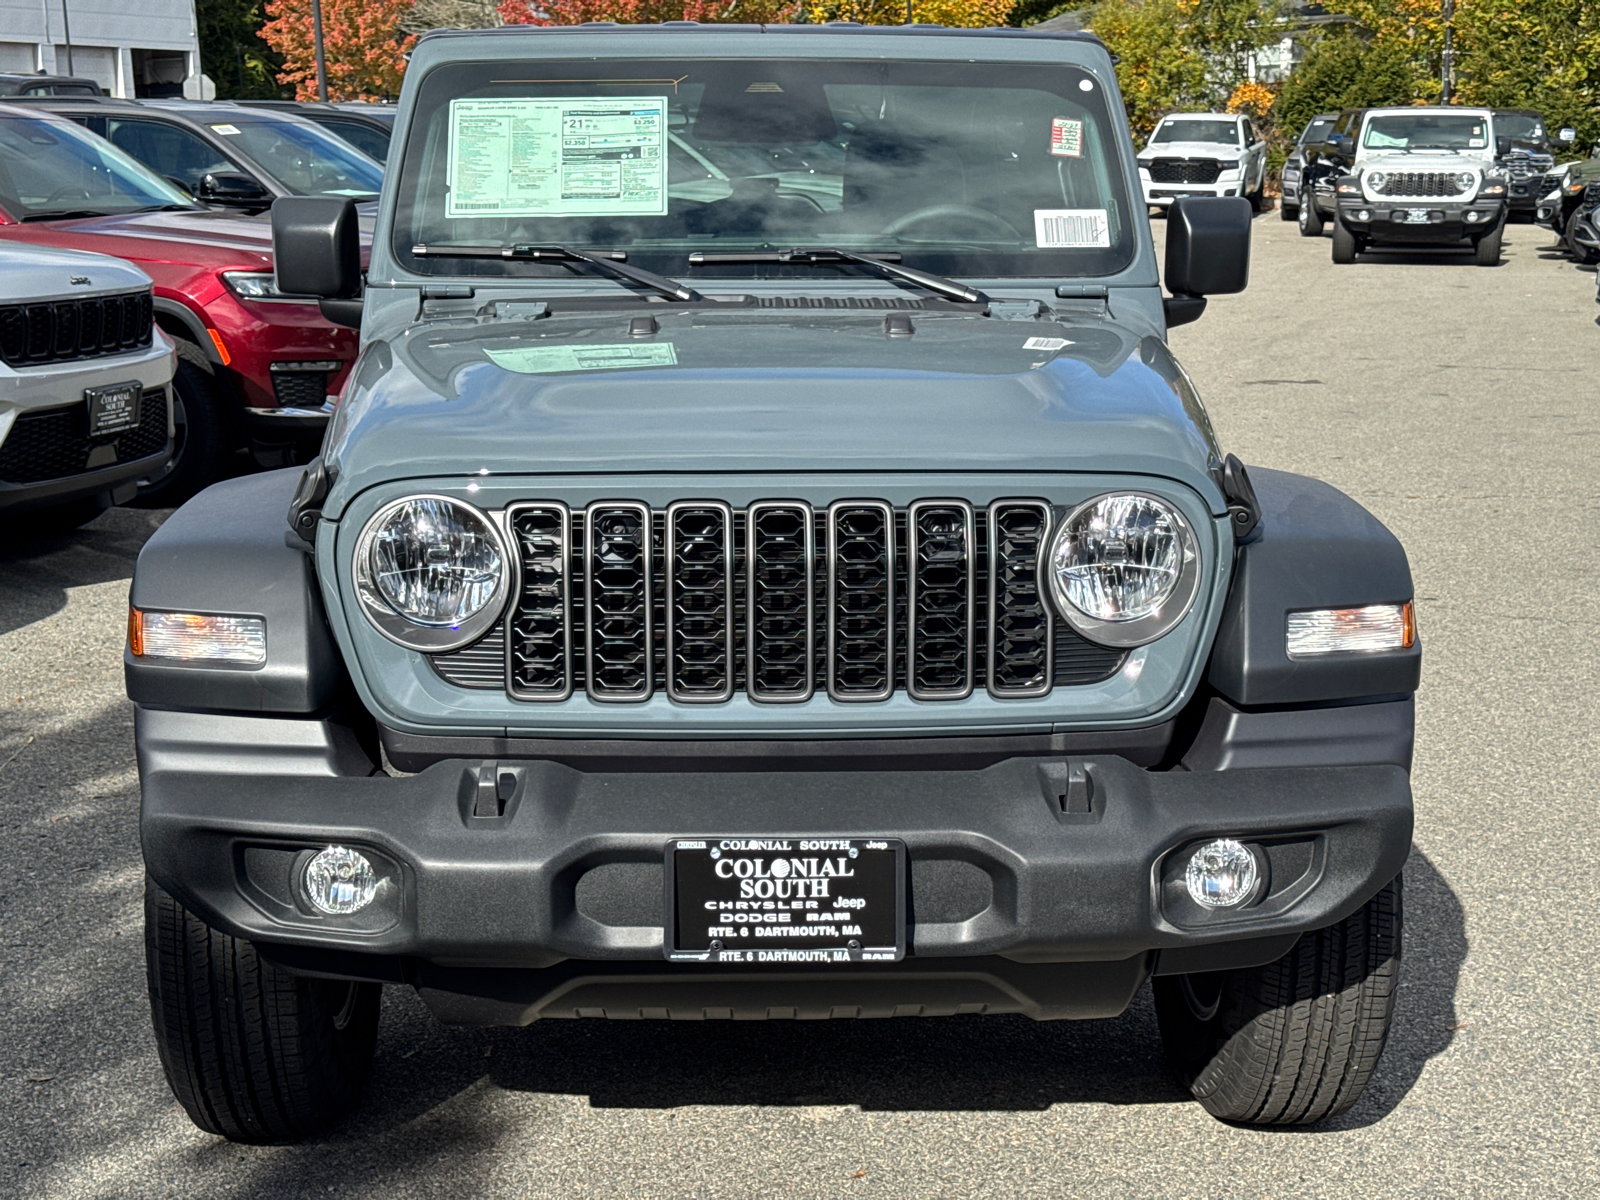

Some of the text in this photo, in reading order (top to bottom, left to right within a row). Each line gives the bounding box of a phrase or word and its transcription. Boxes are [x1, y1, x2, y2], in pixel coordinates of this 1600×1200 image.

[569, 119, 583, 128] 21
[720, 840, 851, 851] COLONIAL SOUTH
[865, 841, 888, 850] Jeep
[715, 857, 855, 879] COLONIAL
[740, 878, 830, 899] SOUTH
[704, 896, 866, 910] CHRYSLER Jeep
[720, 912, 851, 923] DODGE RAM
[708, 925, 862, 938] RTE. 6 DARTMOUTH, MA
[719, 951, 744, 962] RTE.
[746, 951, 754, 962] 6
[758, 951, 832, 963] DARTMOUTH,
[834, 951, 851, 961] MA
